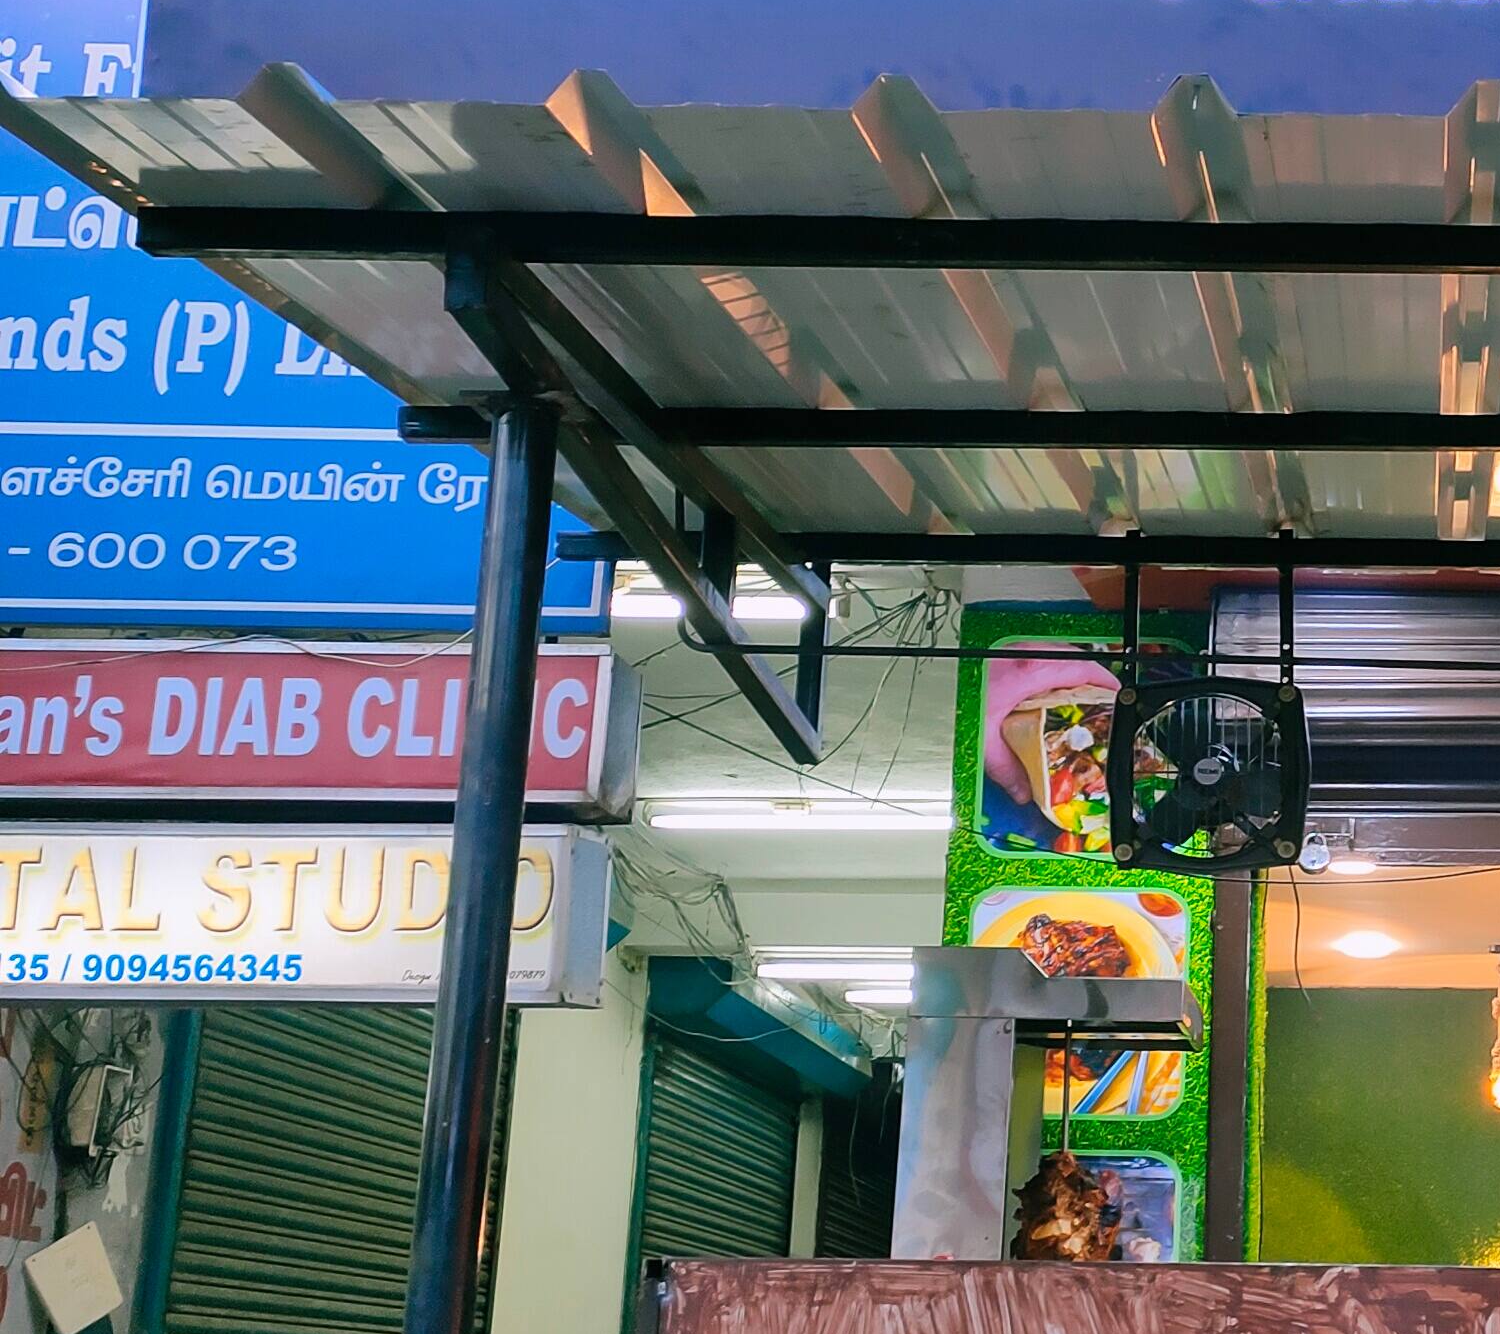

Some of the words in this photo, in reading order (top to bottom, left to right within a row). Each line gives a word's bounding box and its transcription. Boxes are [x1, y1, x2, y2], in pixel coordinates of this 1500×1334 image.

[154, 298, 250, 397] (P)
[47, 532, 167, 569] 600
[183, 535, 298, 572] 073
[147, 676, 323, 757] DIAB
[347, 677, 589, 759] CLIC
[197, 846, 555, 932] STUDO
[0, 953, 49, 981] 35
[82, 954, 303, 982] 9094564345
